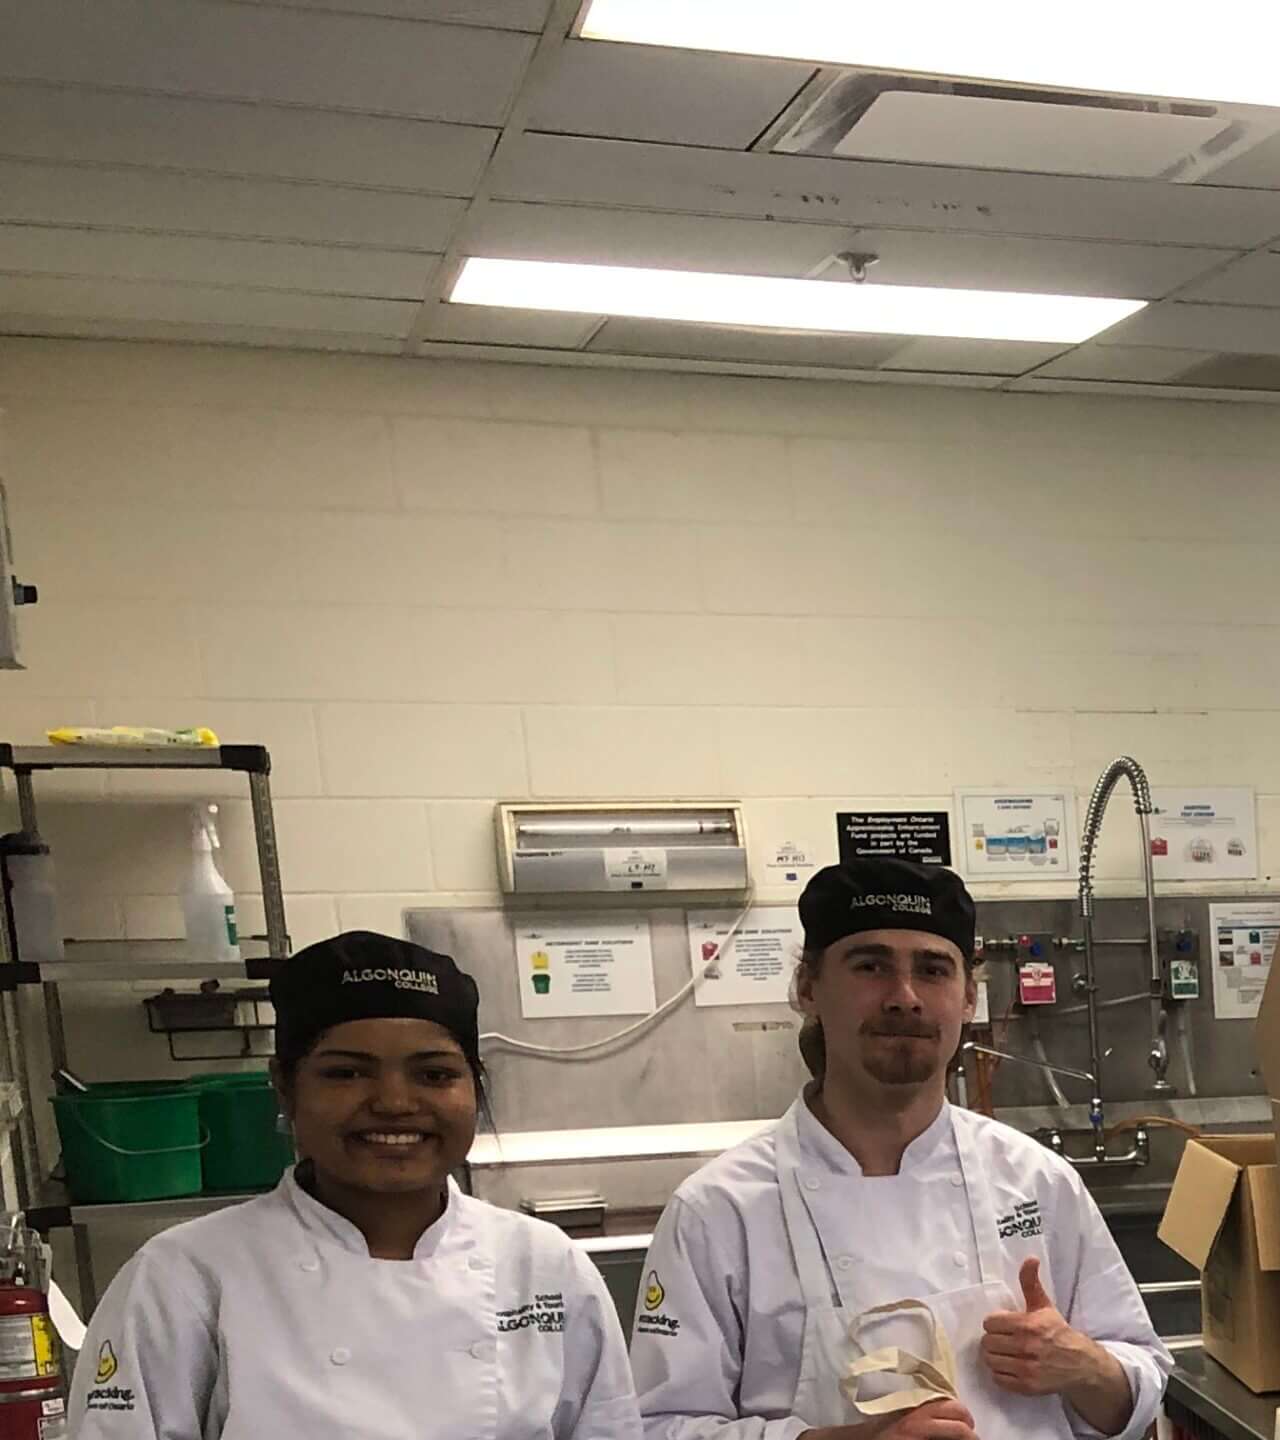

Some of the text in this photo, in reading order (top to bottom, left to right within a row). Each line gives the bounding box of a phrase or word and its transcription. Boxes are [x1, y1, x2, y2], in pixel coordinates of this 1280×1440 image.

[850, 894, 931, 909] ALGONQUIN
[341, 968, 437, 985] ALGONQUIN
[395, 980, 439, 995] COLLEGE
